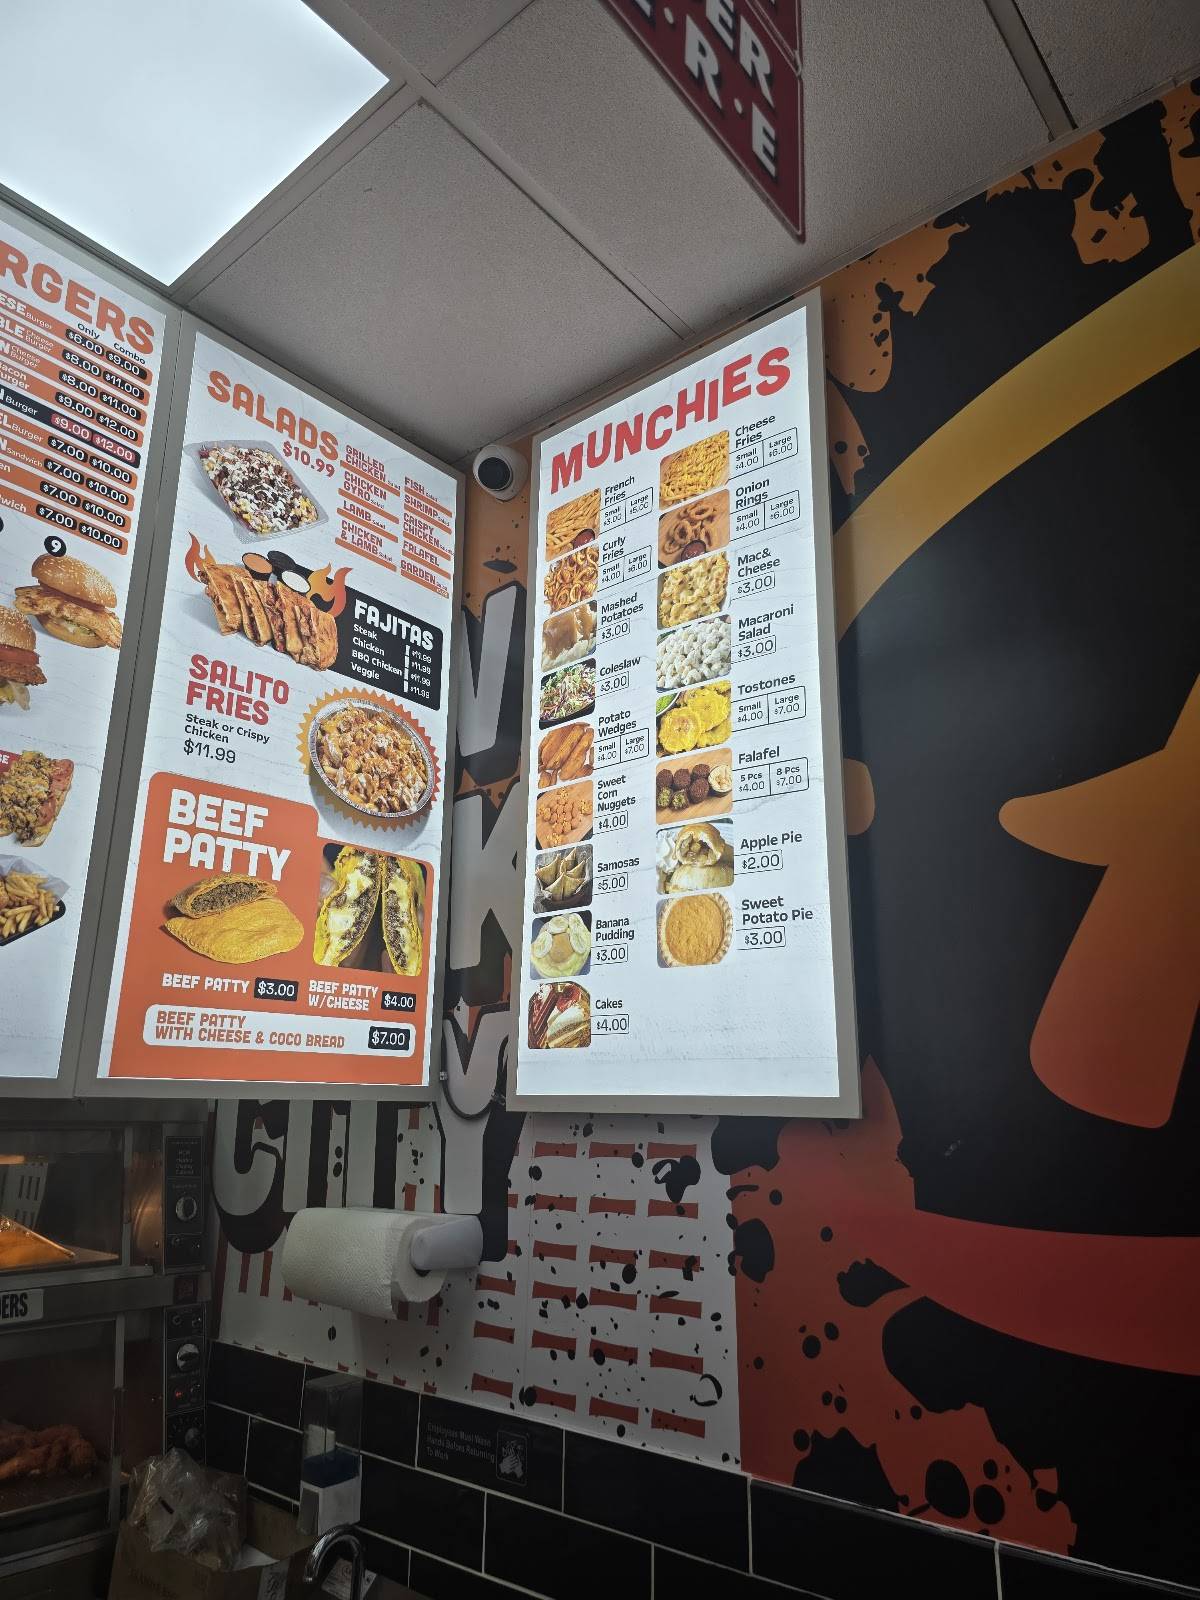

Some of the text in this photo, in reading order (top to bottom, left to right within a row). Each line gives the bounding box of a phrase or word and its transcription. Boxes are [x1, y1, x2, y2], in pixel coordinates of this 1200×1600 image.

[0, 239, 155, 355] RGERS
[77, 322, 100, 340] Only
[68, 330, 103, 355] $6.00
[108, 351, 140, 375] $9.00
[65, 351, 140, 398] $8.00 $11.00
[62, 372, 137, 418] $8.00 $11.00
[58, 394, 136, 440] $9.00 $12.00
[207, 370, 339, 461] SALADS
[551, 346, 791, 495] MUNCHIES
[735, 415, 776, 437] Cheese
[5, 395, 133, 461] Burger $9.00 $12.00
[735, 431, 762, 449] Fries
[736, 435, 792, 462] Small Large
[11, 422, 130, 482] Burger $7.00 $10.00
[282, 440, 335, 479] $10.99
[345, 444, 385, 472] GRILLED
[735, 442, 793, 470] $4.00 $6.00
[345, 453, 386, 482] CHICKEN
[47, 461, 127, 504] $7.00 $10.00
[343, 480, 371, 502] GYRO
[344, 470, 387, 501] CHICKEN
[404, 476, 425, 496] FISH
[604, 475, 635, 496] French
[735, 478, 770, 497] Onion
[43, 483, 124, 527] $7.00 $10.00
[404, 494, 439, 518] SHRIMP
[604, 490, 626, 507] Fries
[630, 494, 649, 507] Large
[735, 491, 769, 510] Rings
[343, 500, 372, 522] LAMB
[735, 505, 795, 532] $4.00 $6.00
[736, 497, 794, 523] Small Large
[39, 507, 120, 549] $7.00 $10.00
[341, 519, 383, 547] CHICKEN
[403, 512, 435, 536] CRISPY
[351, 534, 379, 555] LAMB
[402, 522, 440, 548] CHICKEN
[602, 535, 626, 552] Curly
[51, 539, 62, 553] 9
[403, 540, 440, 567] FALAFEL
[602, 547, 624, 563] Fries
[602, 552, 647, 575] Small Large
[627, 560, 648, 573] $6.00
[737, 547, 772, 567] Mac&
[400, 559, 436, 585] GARDEN
[737, 558, 780, 578] Cheese
[737, 575, 772, 594] $3.00
[601, 591, 638, 615] Mashed
[354, 598, 434, 651] FAJITAS
[601, 603, 644, 625] Potatoes
[738, 603, 794, 629] Macaroni
[353, 623, 378, 640] Steak
[601, 622, 629, 640] $3.00
[738, 623, 771, 642] Salad
[352, 636, 385, 656] Chicken
[737, 639, 773, 658] $3.00
[350, 661, 380, 680] Veggie
[351, 649, 369, 664] BBQ
[371, 657, 402, 676] Chicken
[599, 656, 641, 677] Coleslaw
[189, 654, 289, 705] SALITO
[600, 675, 627, 692] $3.00
[737, 674, 796, 695] Tostones
[185, 680, 270, 726] FRIES
[737, 702, 800, 723] $4.00 $7.00
[738, 694, 800, 713] Small Large
[185, 713, 270, 745] Steak or Crispy
[597, 720, 637, 738] Wedges
[598, 710, 631, 727] Potato
[184, 724, 229, 744] Chicken
[598, 735, 645, 753] Small Large
[183, 738, 236, 764] $11.99
[624, 743, 645, 755] $7.00
[738, 745, 780, 765] Falafel
[747, 772, 763, 781] Pcs
[784, 766, 800, 775] Pcs
[597, 774, 627, 790] Sweet
[738, 774, 802, 793] $4.00 $7.00
[597, 788, 618, 801] Corn
[597, 796, 636, 813] Nuggets
[168, 788, 269, 838] BEEF
[598, 814, 627, 830] $4.00
[740, 831, 803, 852] Apple Pie
[163, 827, 291, 882] PATTY
[597, 857, 640, 873] Samosas
[742, 854, 780, 870] $2.00
[597, 876, 626, 891] $5.00
[741, 895, 784, 911] Sweet
[595, 917, 630, 930] Banana
[742, 907, 814, 926] Potato Pie
[595, 928, 635, 942] Pudding
[744, 930, 783, 946] $3.00
[596, 947, 626, 962] $3.00
[162, 972, 295, 997] BEEF PATTY $3.00
[308, 979, 414, 1009] BEEF PATTY $4.00
[308, 994, 370, 1011] W/CHEESE
[595, 998, 623, 1010] Cakes
[156, 1010, 247, 1029] BEEF PATTY
[596, 1017, 628, 1032] $4.00
[155, 1025, 345, 1049] WITH CHEESE & COCO BREAD
[371, 1030, 405, 1046] $7.00
[0, 1291, 28, 1319] ERS
